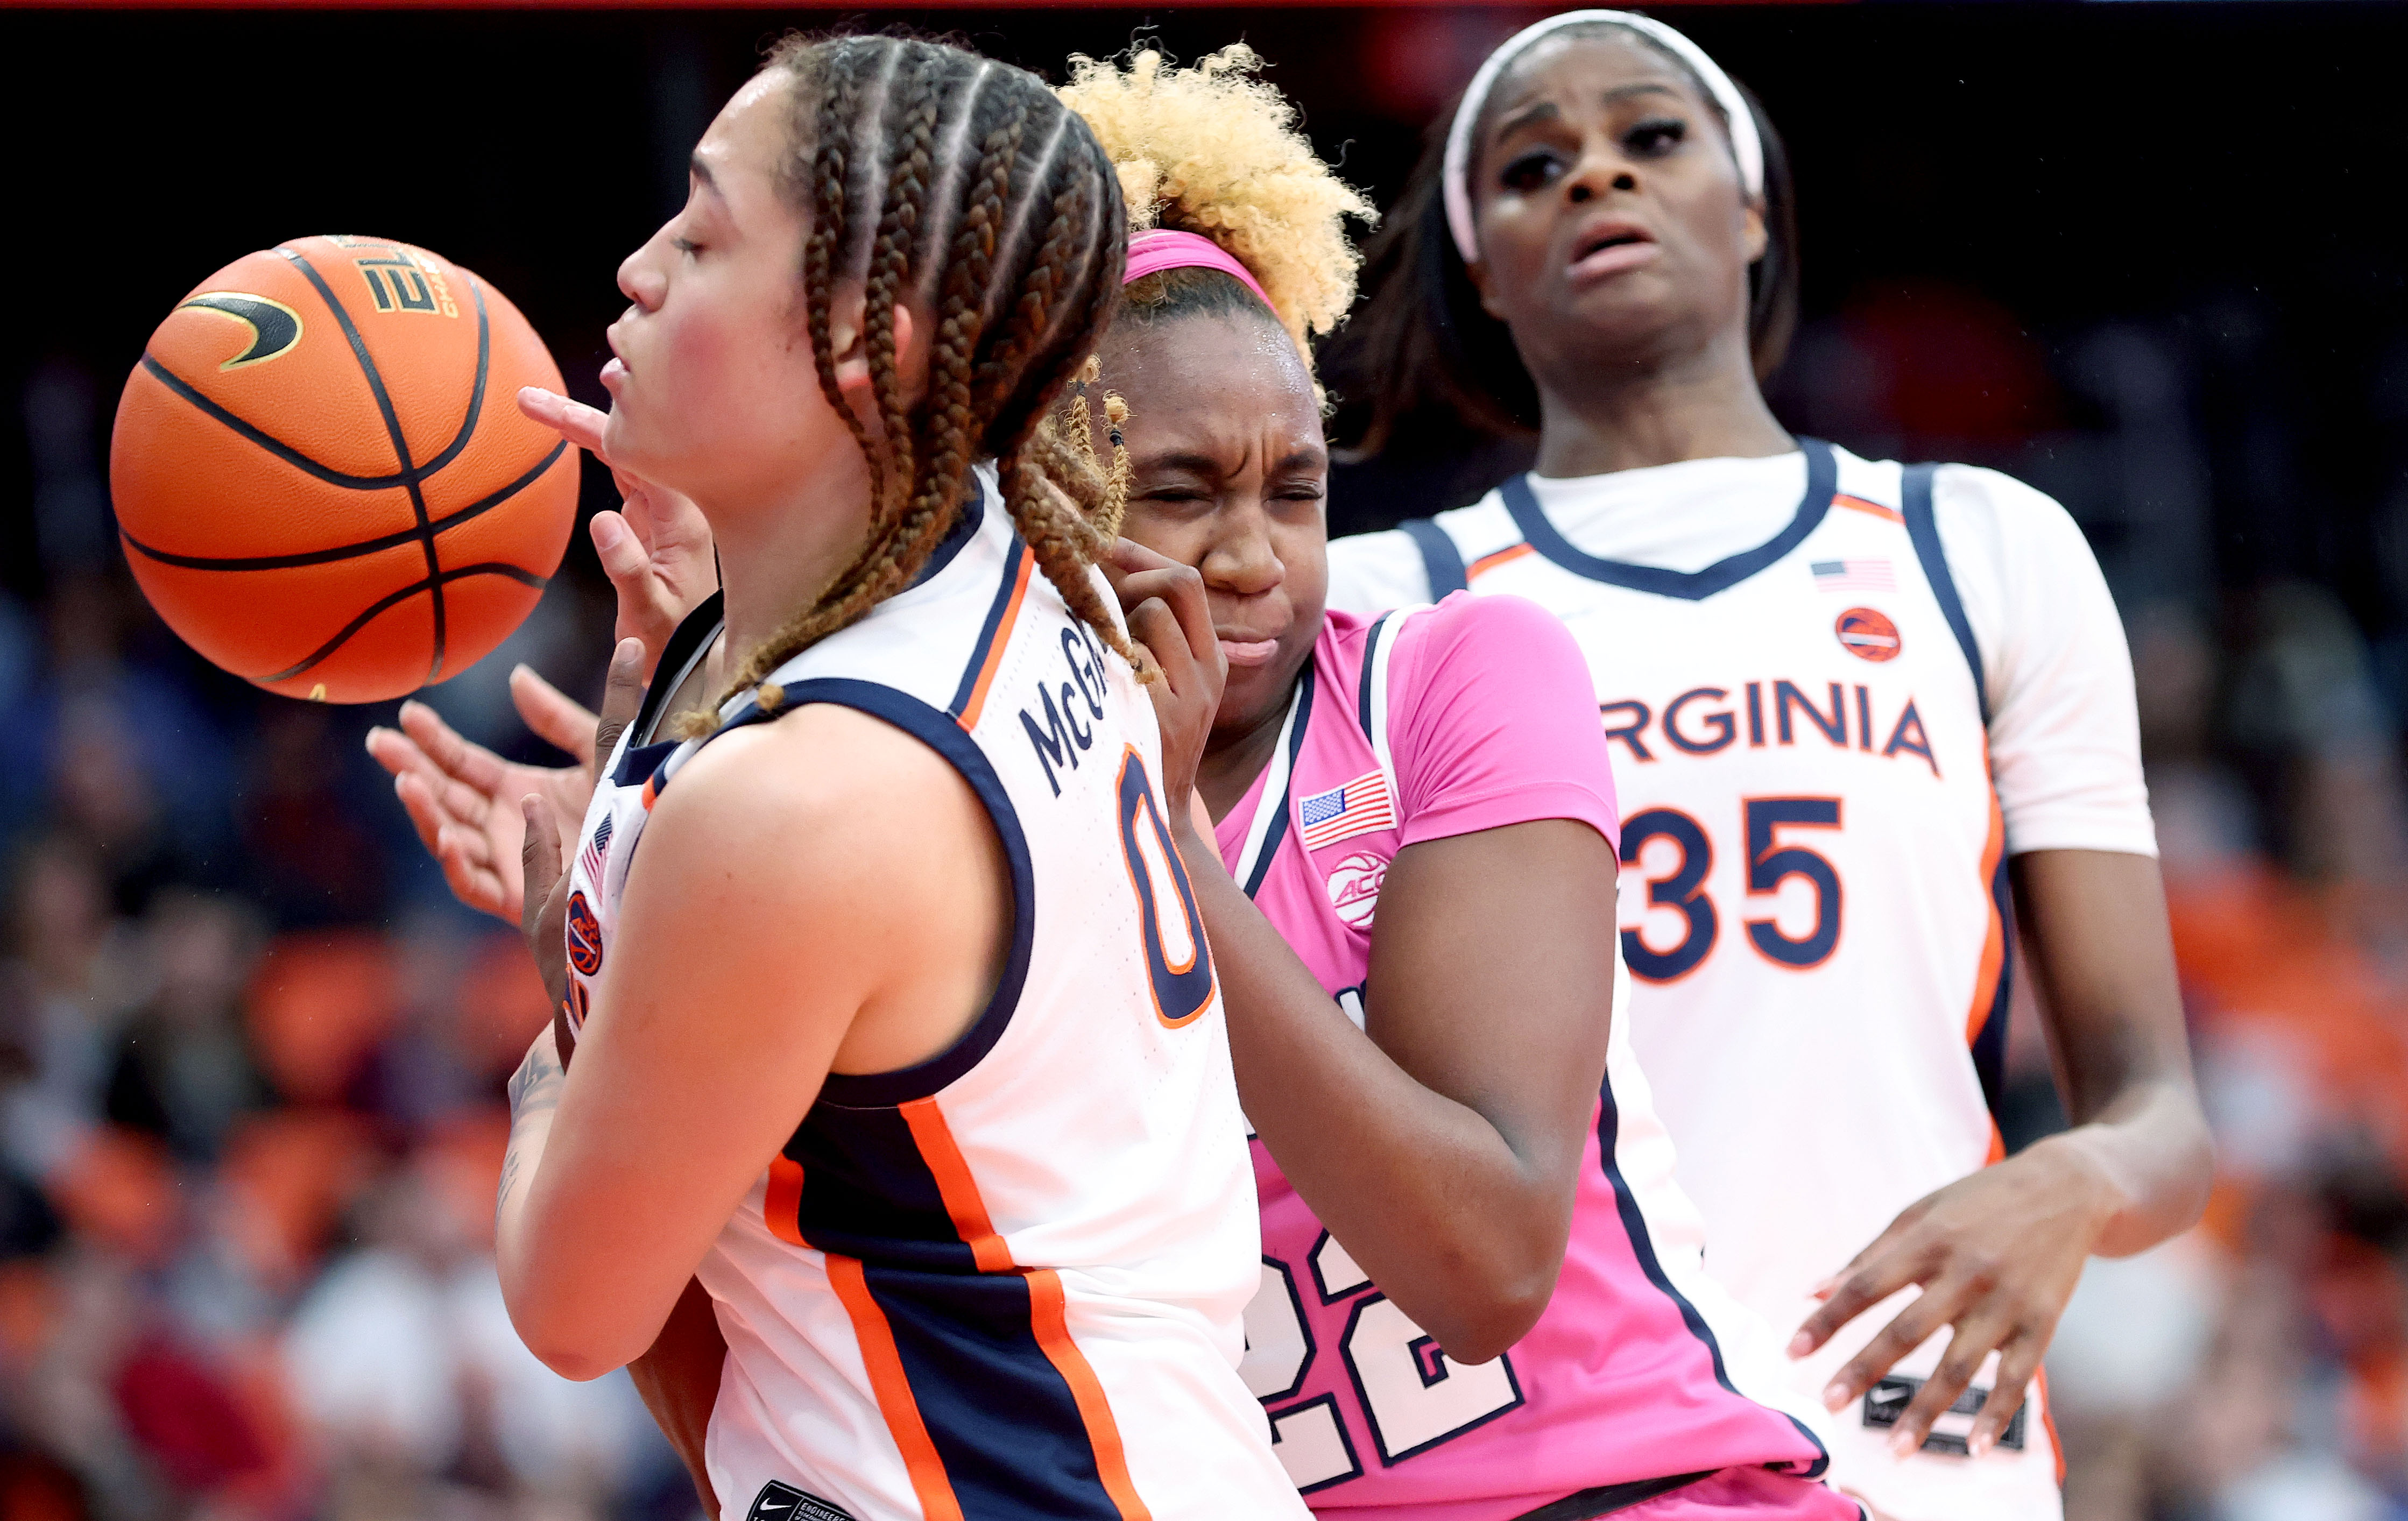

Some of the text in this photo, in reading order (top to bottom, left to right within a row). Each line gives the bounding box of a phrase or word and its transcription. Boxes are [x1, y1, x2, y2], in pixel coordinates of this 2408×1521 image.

[1599, 680, 1943, 780] RGINIA
[1115, 742, 1216, 1029] 0
[1620, 795, 1844, 988] 35
[1237, 1227, 1526, 1495] 22
